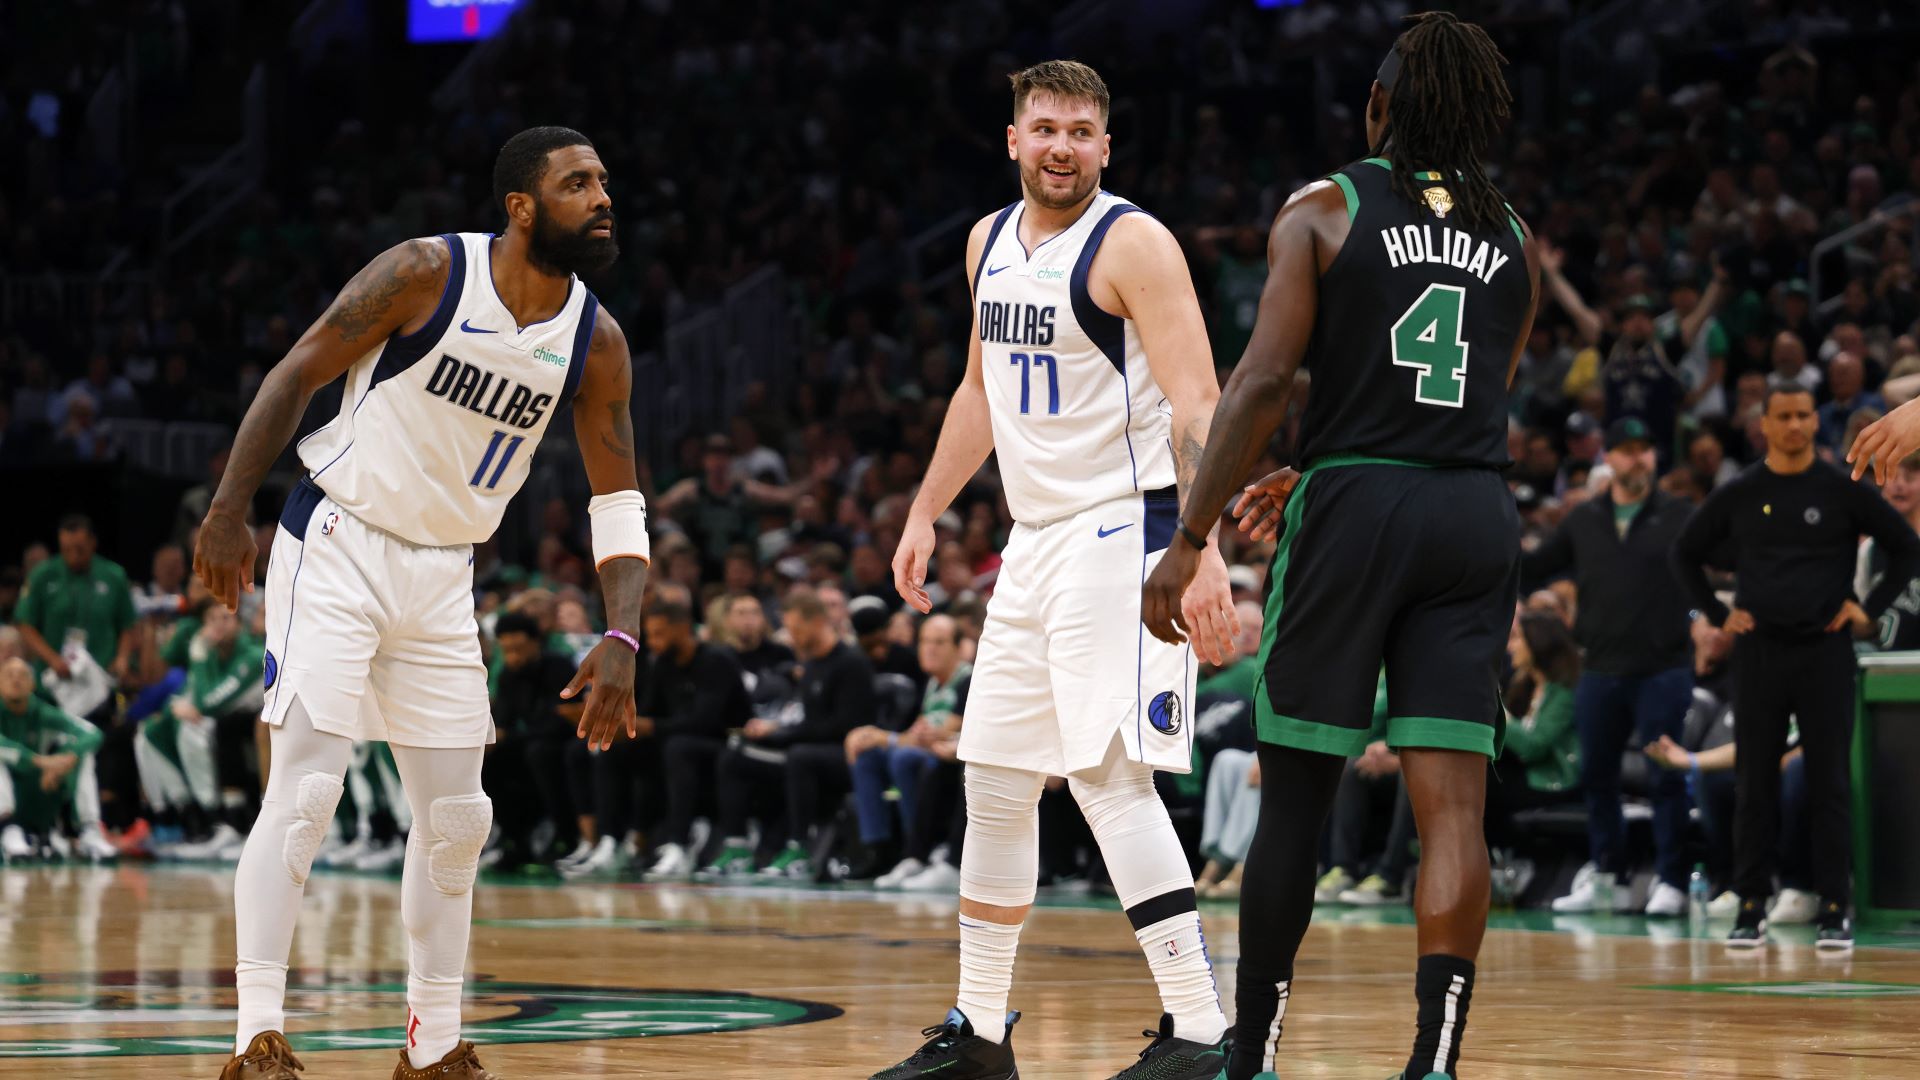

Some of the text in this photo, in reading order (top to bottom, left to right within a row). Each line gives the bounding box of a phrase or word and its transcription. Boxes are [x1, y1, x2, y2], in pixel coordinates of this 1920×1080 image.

[1037, 267, 1065, 279] chime
[1380, 224, 1509, 285] HOLIDAY
[979, 300, 1057, 347] DALLAS
[1391, 282, 1469, 408] 4
[533, 346, 567, 368] chime
[1009, 351, 1060, 416] 77
[424, 353, 554, 430] DALLAS
[468, 428, 527, 489] 11
